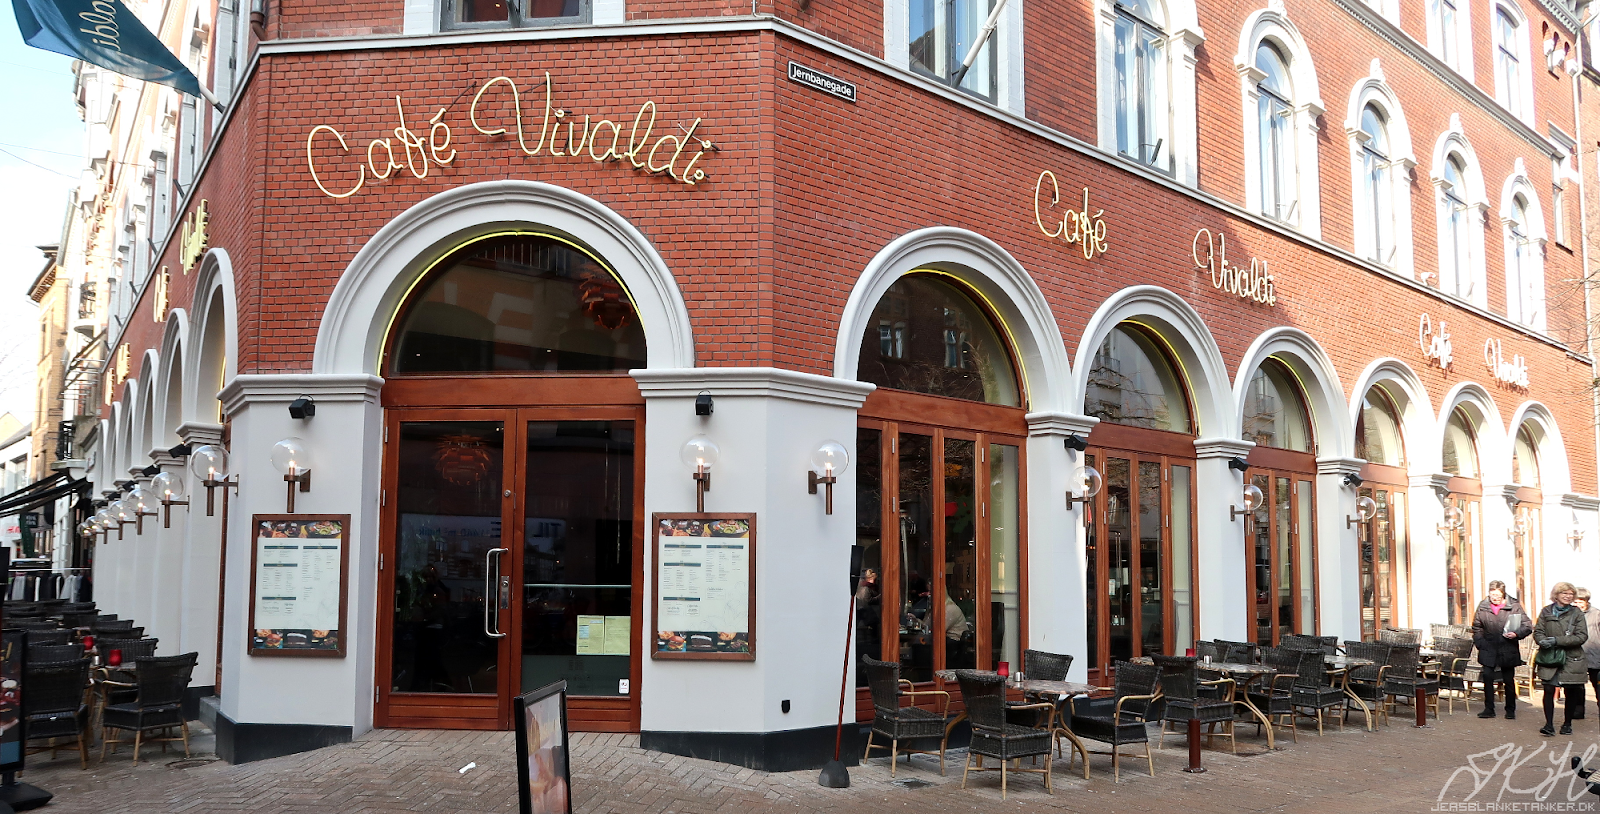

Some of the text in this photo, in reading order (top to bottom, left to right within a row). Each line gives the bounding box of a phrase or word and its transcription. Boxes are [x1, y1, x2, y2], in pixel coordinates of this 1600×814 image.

[307, 71, 712, 199] Café Vivaldi
[792, 65, 852, 96] Jernbanegade
[1035, 170, 1276, 307] Café Vivaldi
